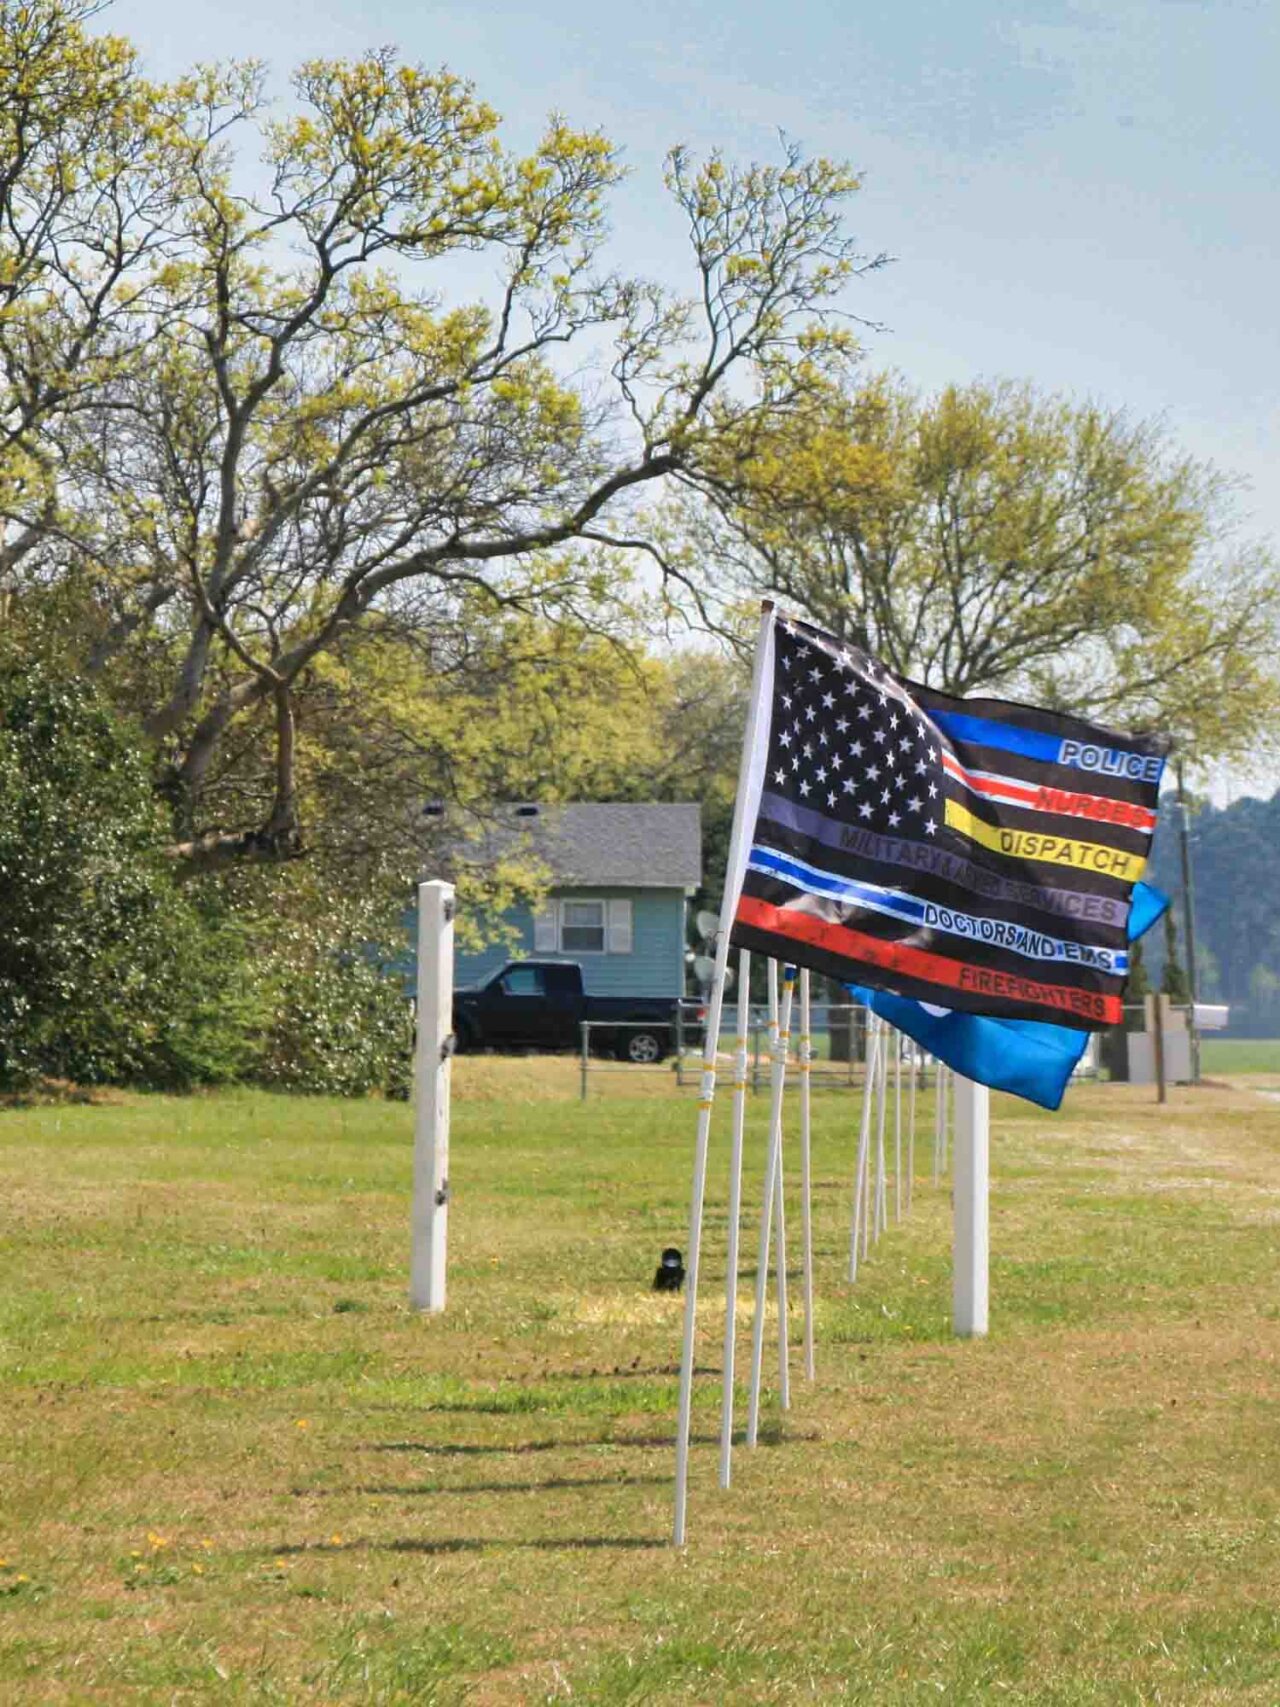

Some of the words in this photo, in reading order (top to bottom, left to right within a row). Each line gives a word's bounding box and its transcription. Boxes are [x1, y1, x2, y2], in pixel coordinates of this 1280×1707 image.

[1060, 741, 1159, 781] POLICE
[1036, 786, 1144, 826] NURSES
[840, 828, 942, 873] MILITARY
[1000, 831, 1129, 875] DISPATCH
[925, 904, 1016, 945] DOCTORS
[1018, 932, 1055, 957] AND
[1064, 943, 1112, 969] EMS
[960, 967, 1105, 1016] FIREFIGHTERS
